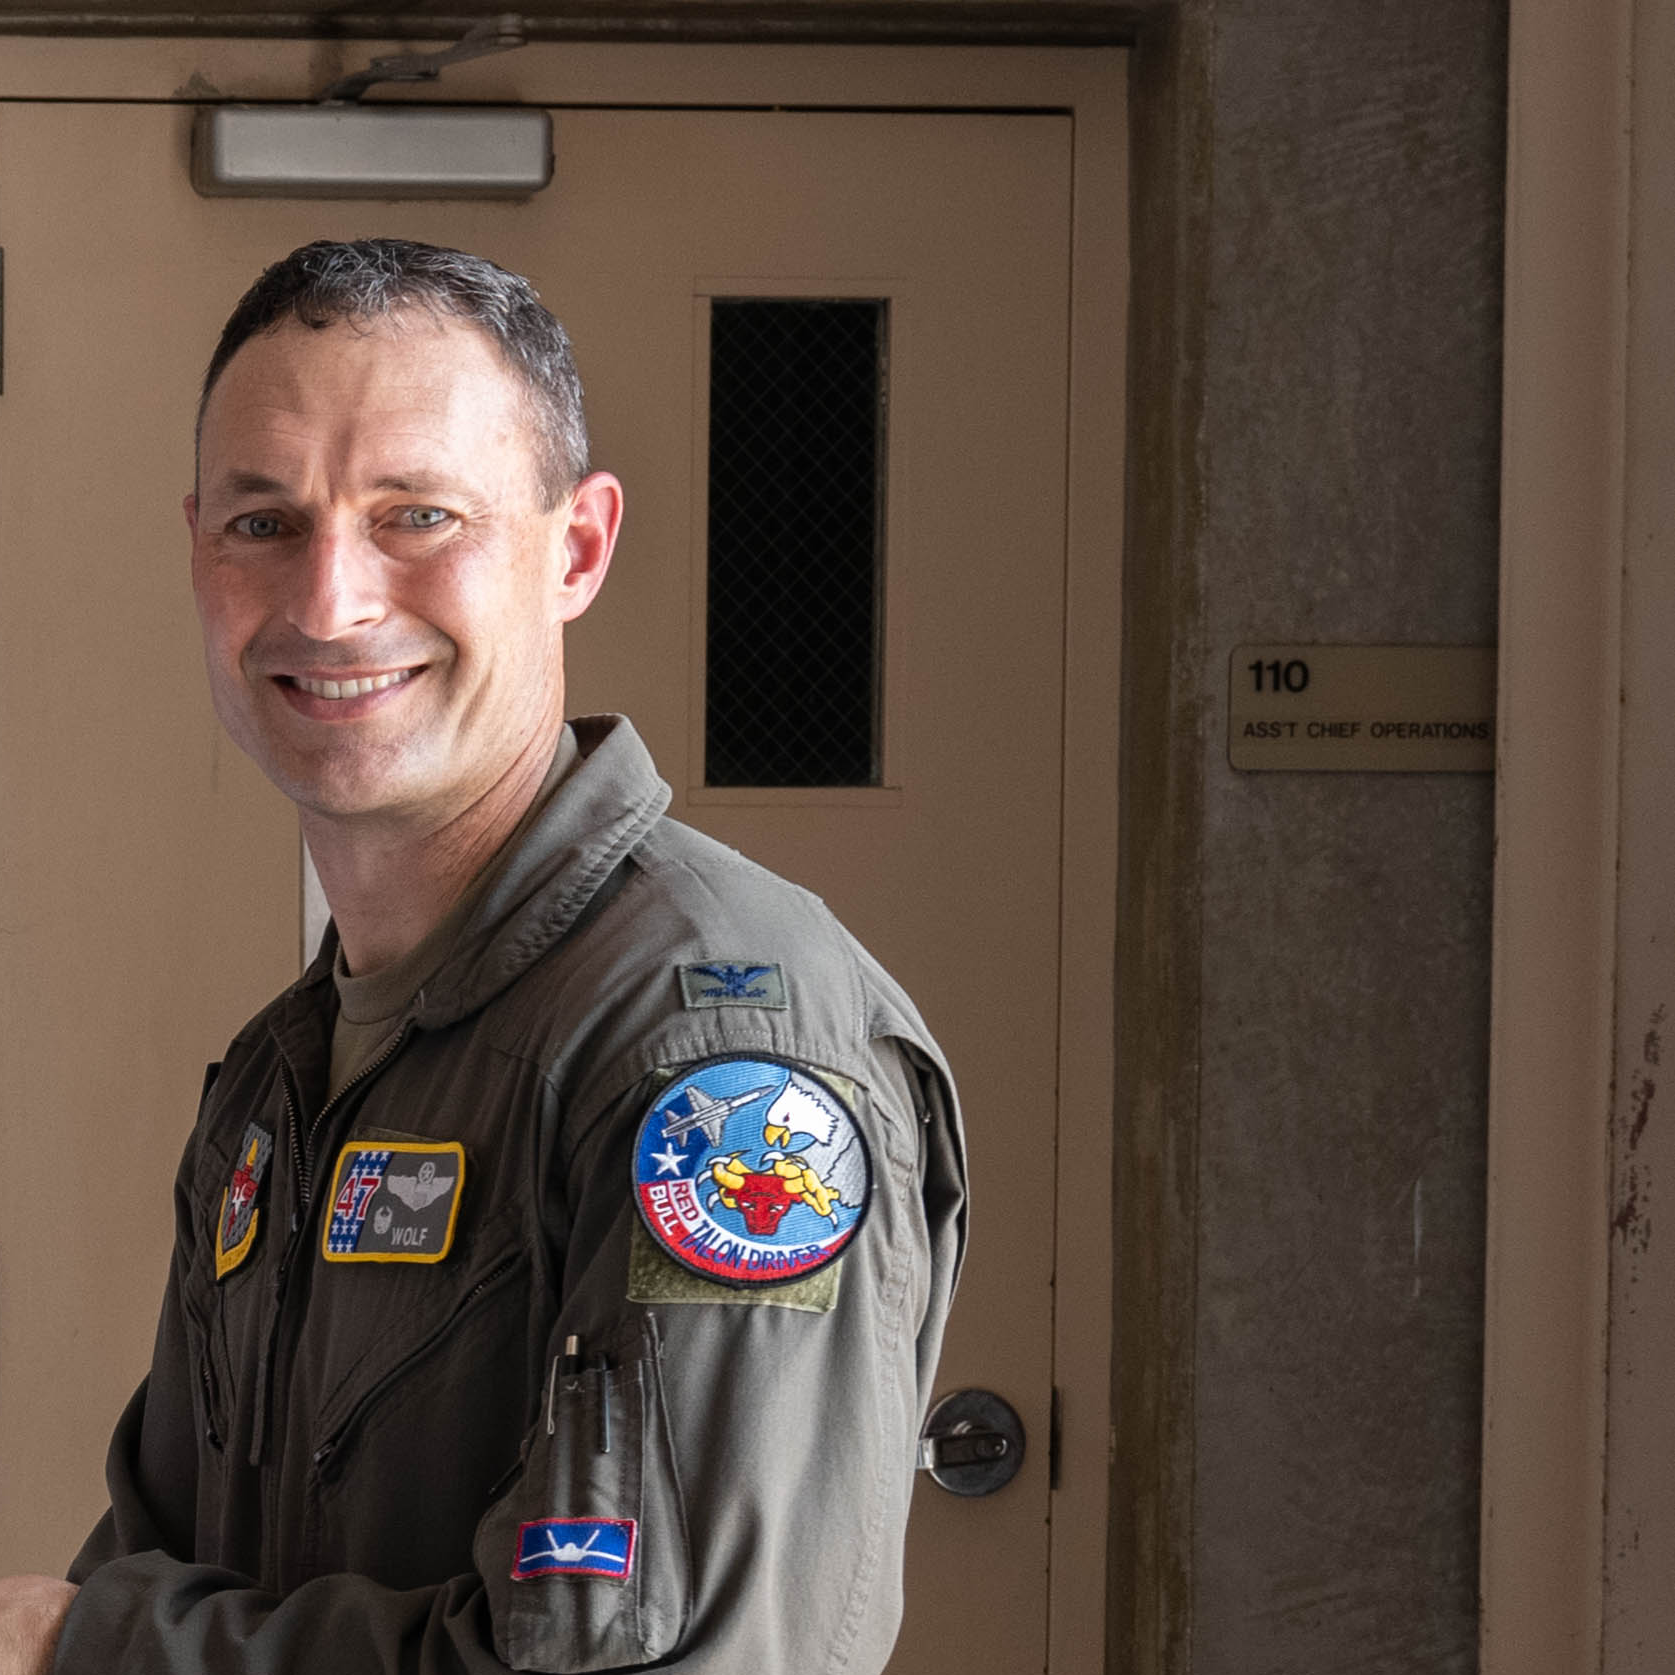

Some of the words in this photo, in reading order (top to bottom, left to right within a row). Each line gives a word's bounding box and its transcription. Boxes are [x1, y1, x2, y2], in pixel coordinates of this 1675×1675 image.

[1248, 659, 1309, 693] 110
[1243, 721, 1298, 738] ASS'T
[1306, 721, 1362, 738] CHIEF
[1370, 721, 1490, 739] OPERATIONS
[334, 1176, 382, 1220] 47
[649, 1185, 679, 1236] BULL
[672, 1182, 699, 1222] RED
[391, 1227, 428, 1246] WOLF
[679, 1219, 746, 1270] TALON
[748, 1244, 829, 1270] DRIVER
